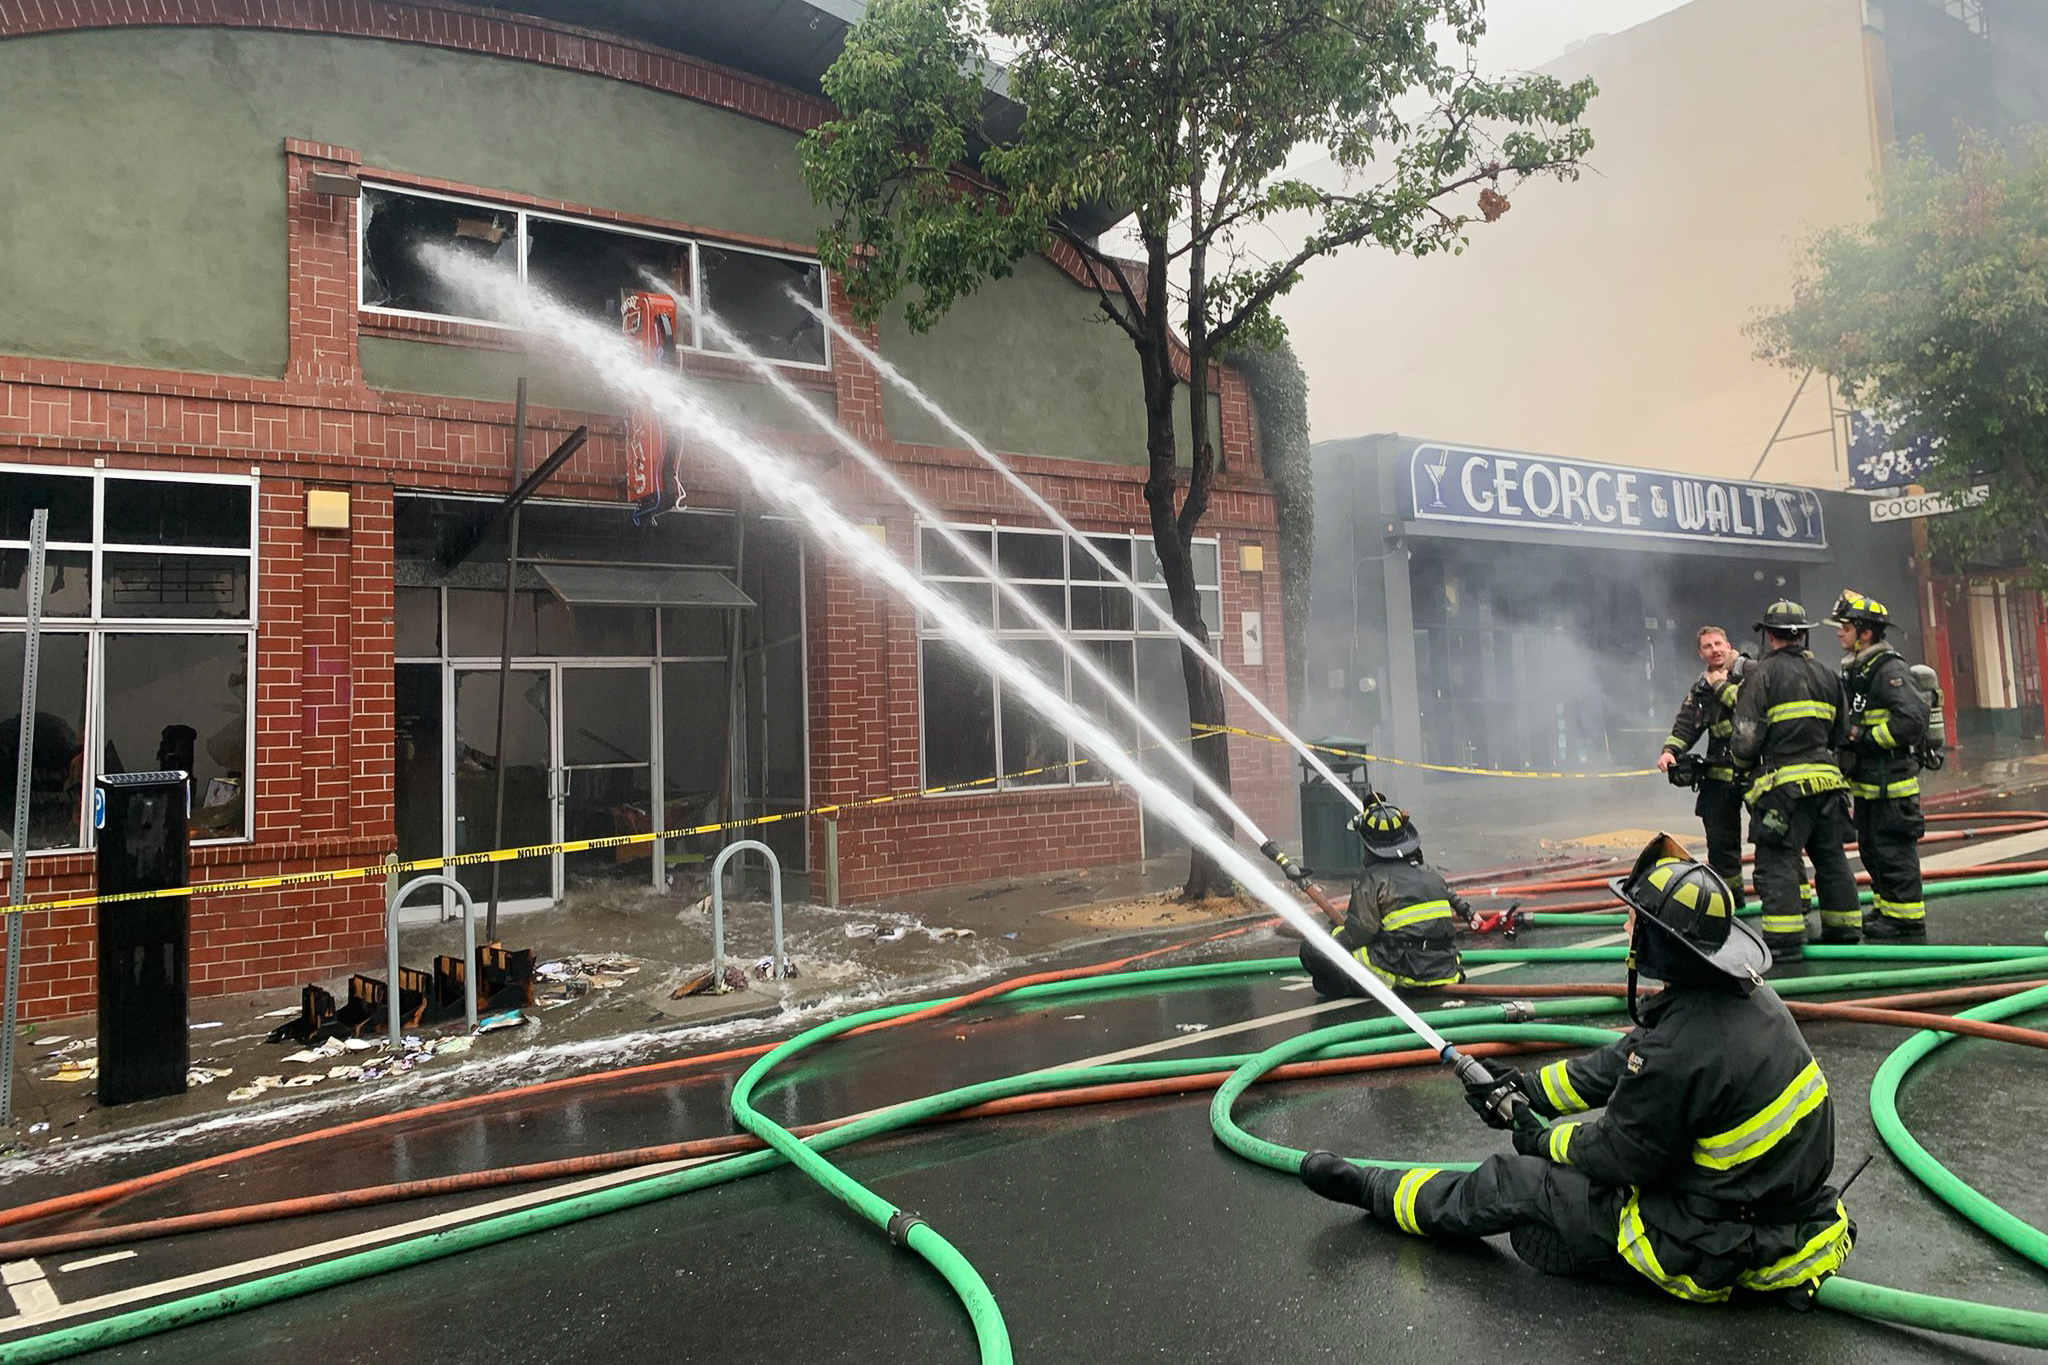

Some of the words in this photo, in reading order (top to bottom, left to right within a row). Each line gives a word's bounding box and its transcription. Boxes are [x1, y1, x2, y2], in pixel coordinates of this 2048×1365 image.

[1461, 456, 1642, 526] GEORGE
[1650, 485, 1668, 518] &
[1672, 480, 1797, 538] WALT'S
[1873, 487, 1989, 518] COCKTALS
[588, 837, 631, 849] CAUTION
[517, 845, 563, 859] CAUTION
[442, 853, 490, 867] CAUTION
[364, 862, 414, 876] CAUTION
